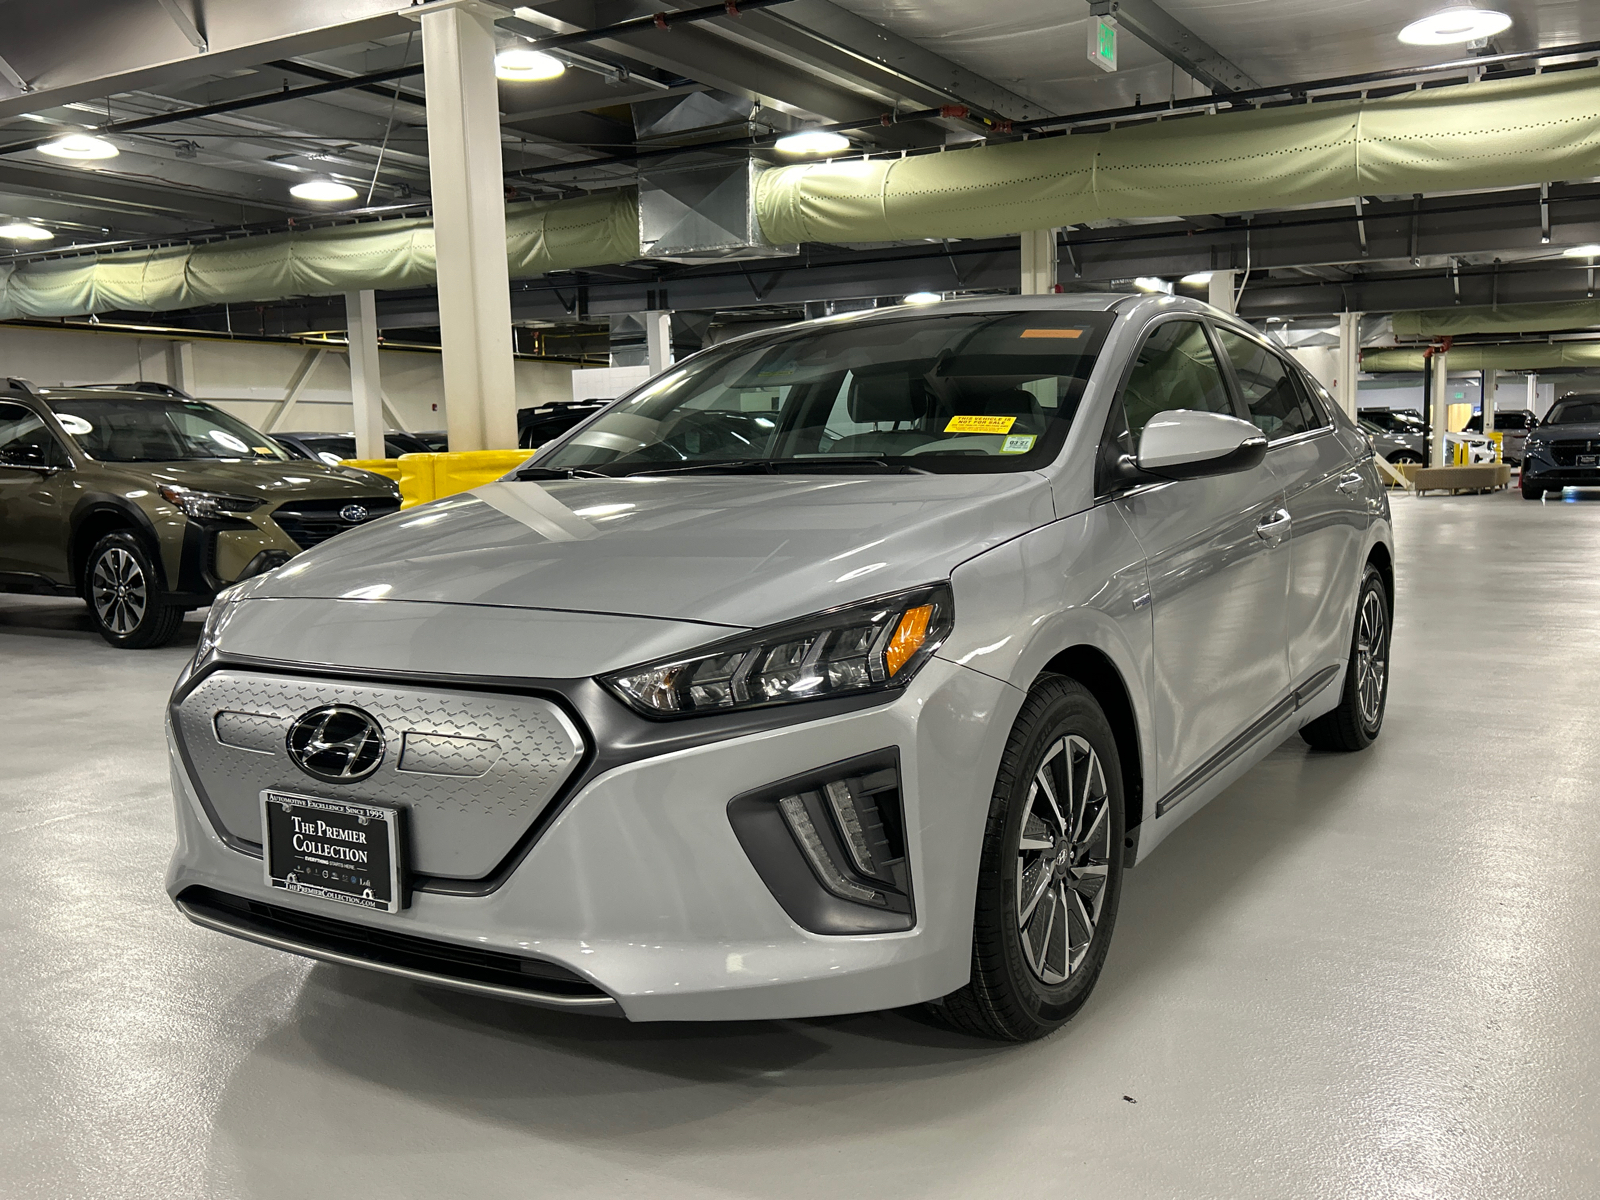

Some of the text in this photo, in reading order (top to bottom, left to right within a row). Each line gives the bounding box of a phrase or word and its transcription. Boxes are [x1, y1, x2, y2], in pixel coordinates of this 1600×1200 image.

[269, 793, 384, 819] AUTOMOTIVE EXCELLENCE SINCE 1995
[291, 815, 367, 845] THE PREMIER
[292, 833, 368, 864] COLLECTION
